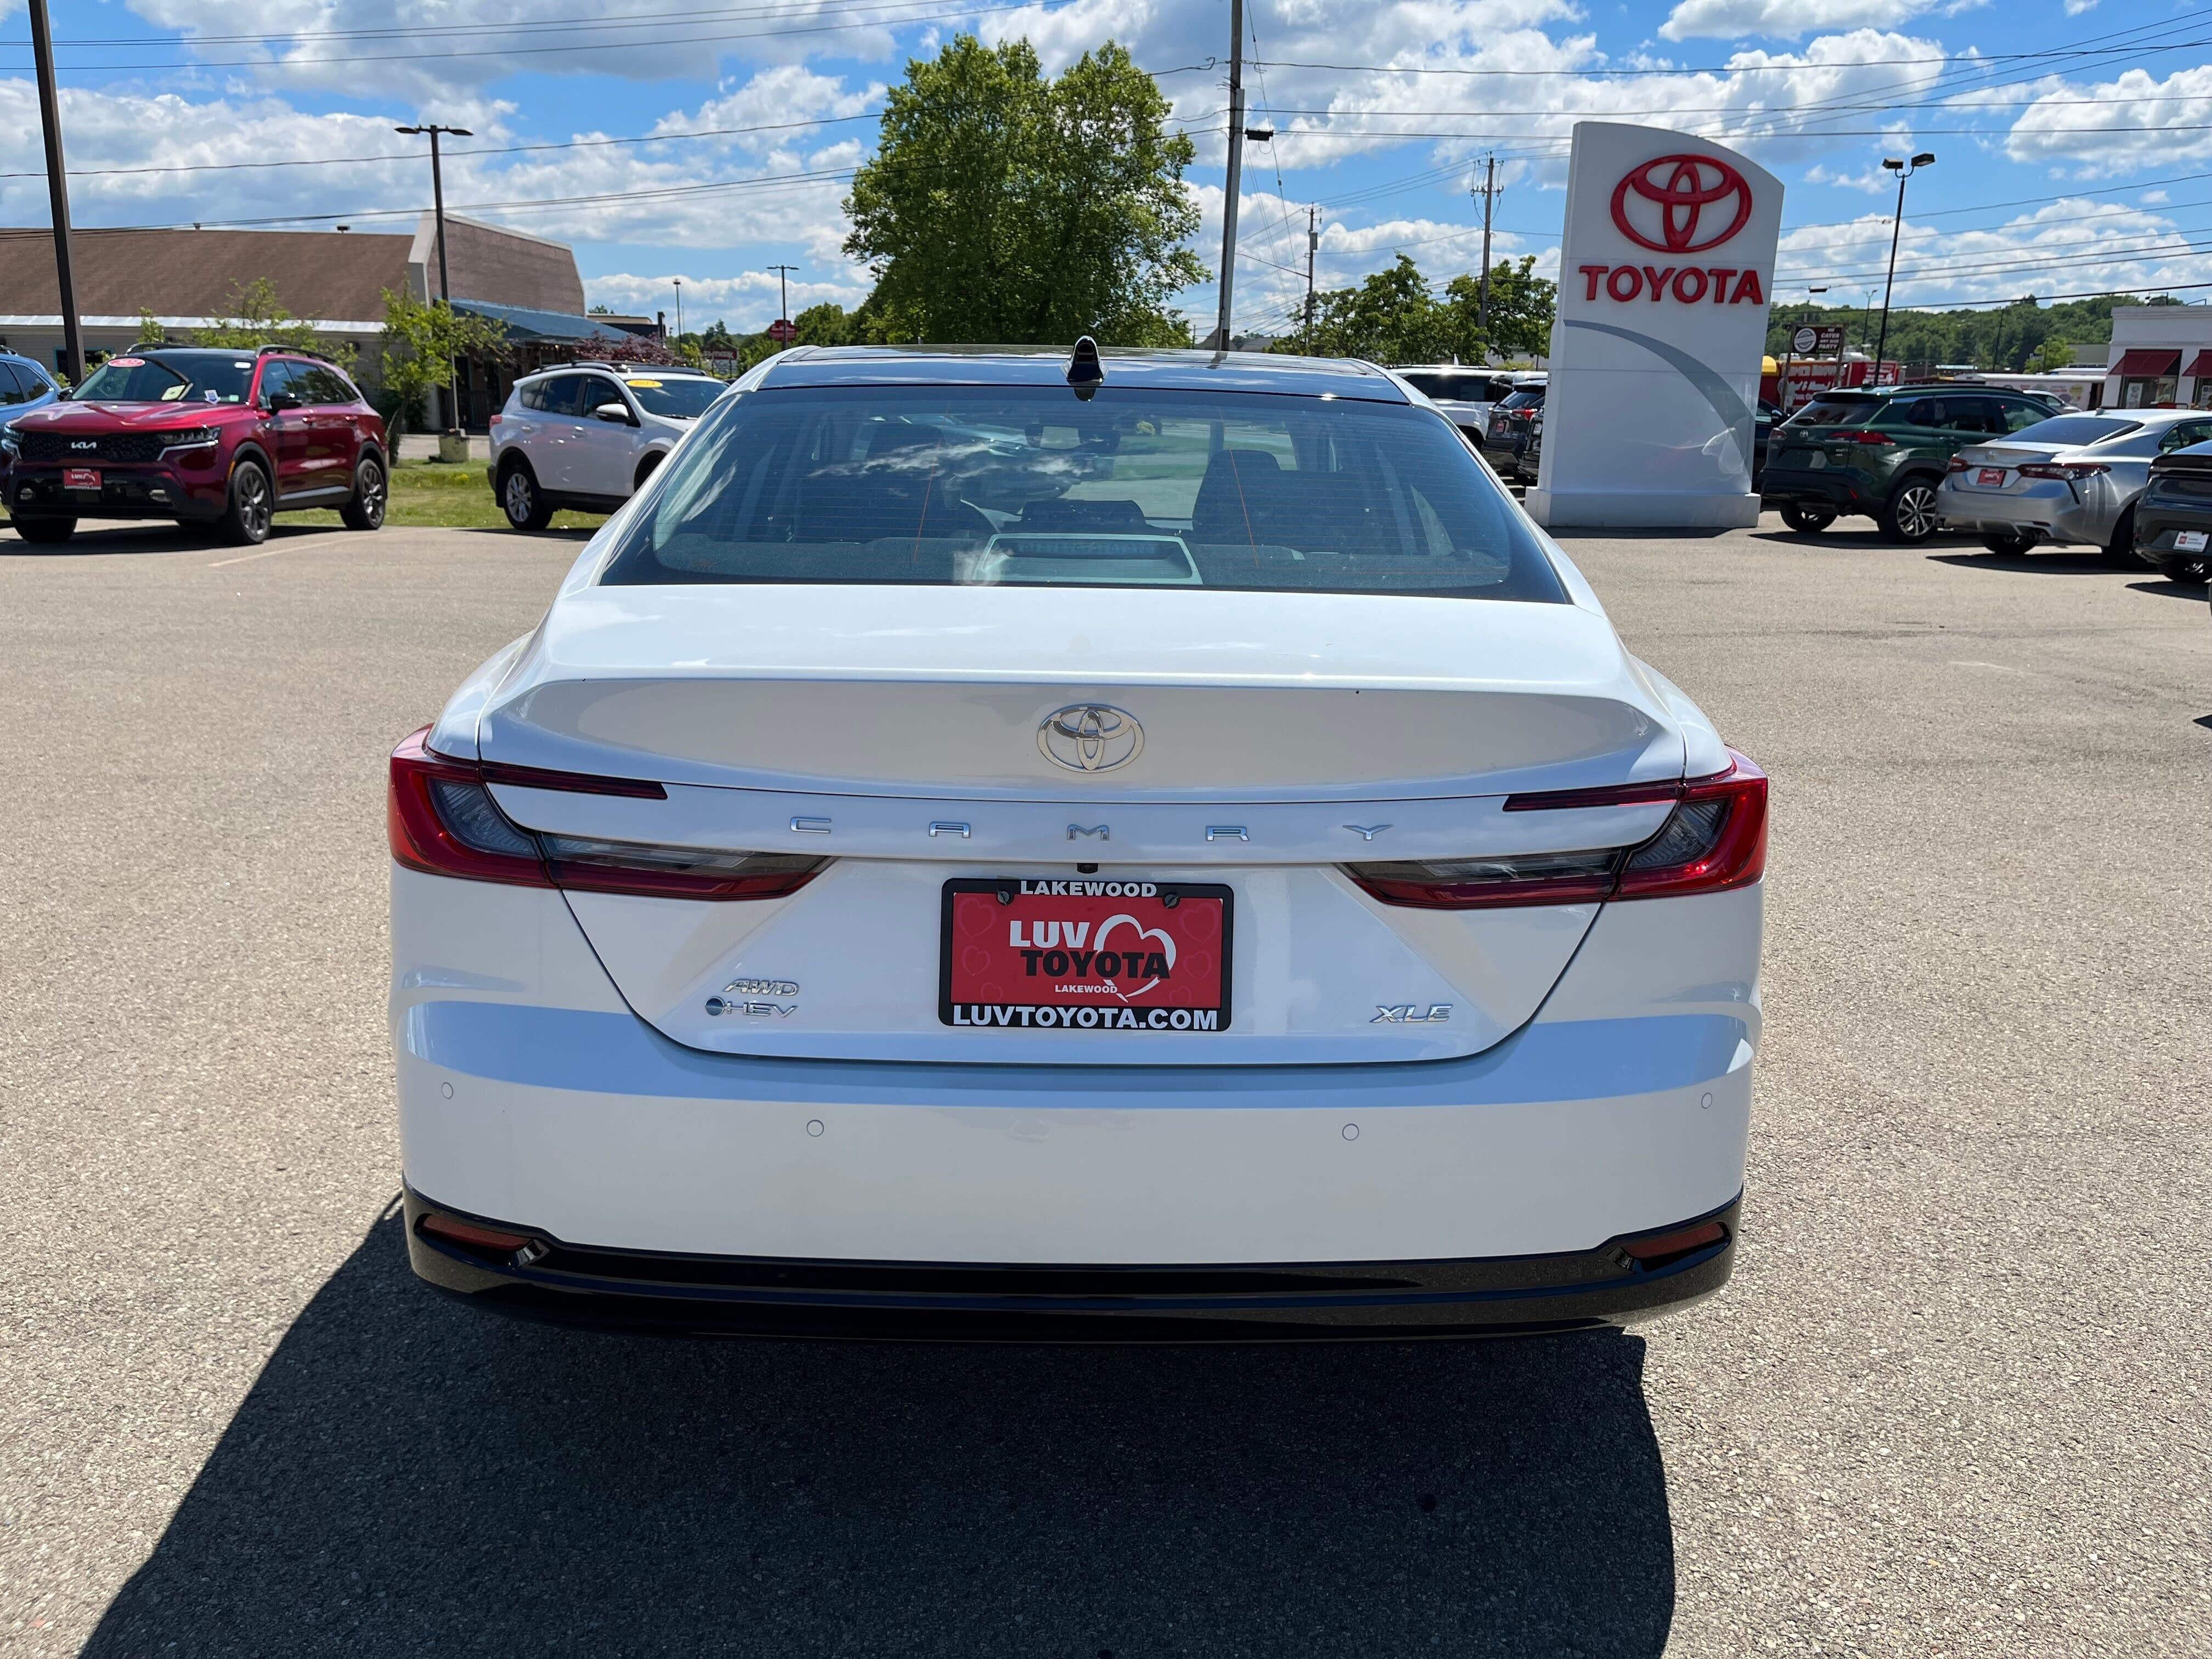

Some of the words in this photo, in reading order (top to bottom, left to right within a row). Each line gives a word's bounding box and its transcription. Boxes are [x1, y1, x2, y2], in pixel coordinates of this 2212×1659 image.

[1579, 265, 1764, 304] TOYOTA
[71, 441, 97, 449] KIA
[791, 816, 1393, 841] CAMRY
[1020, 880, 1157, 897] LAKEWOOD
[1009, 920, 1090, 949] LUV
[1020, 950, 1171, 979] TOYOTA
[723, 978, 799, 996] AWD
[1054, 984, 1118, 994] LAKEWOOD
[953, 1005, 1217, 1030] LUVTOYOTA.COM
[1369, 1004, 1453, 1023] XLE
